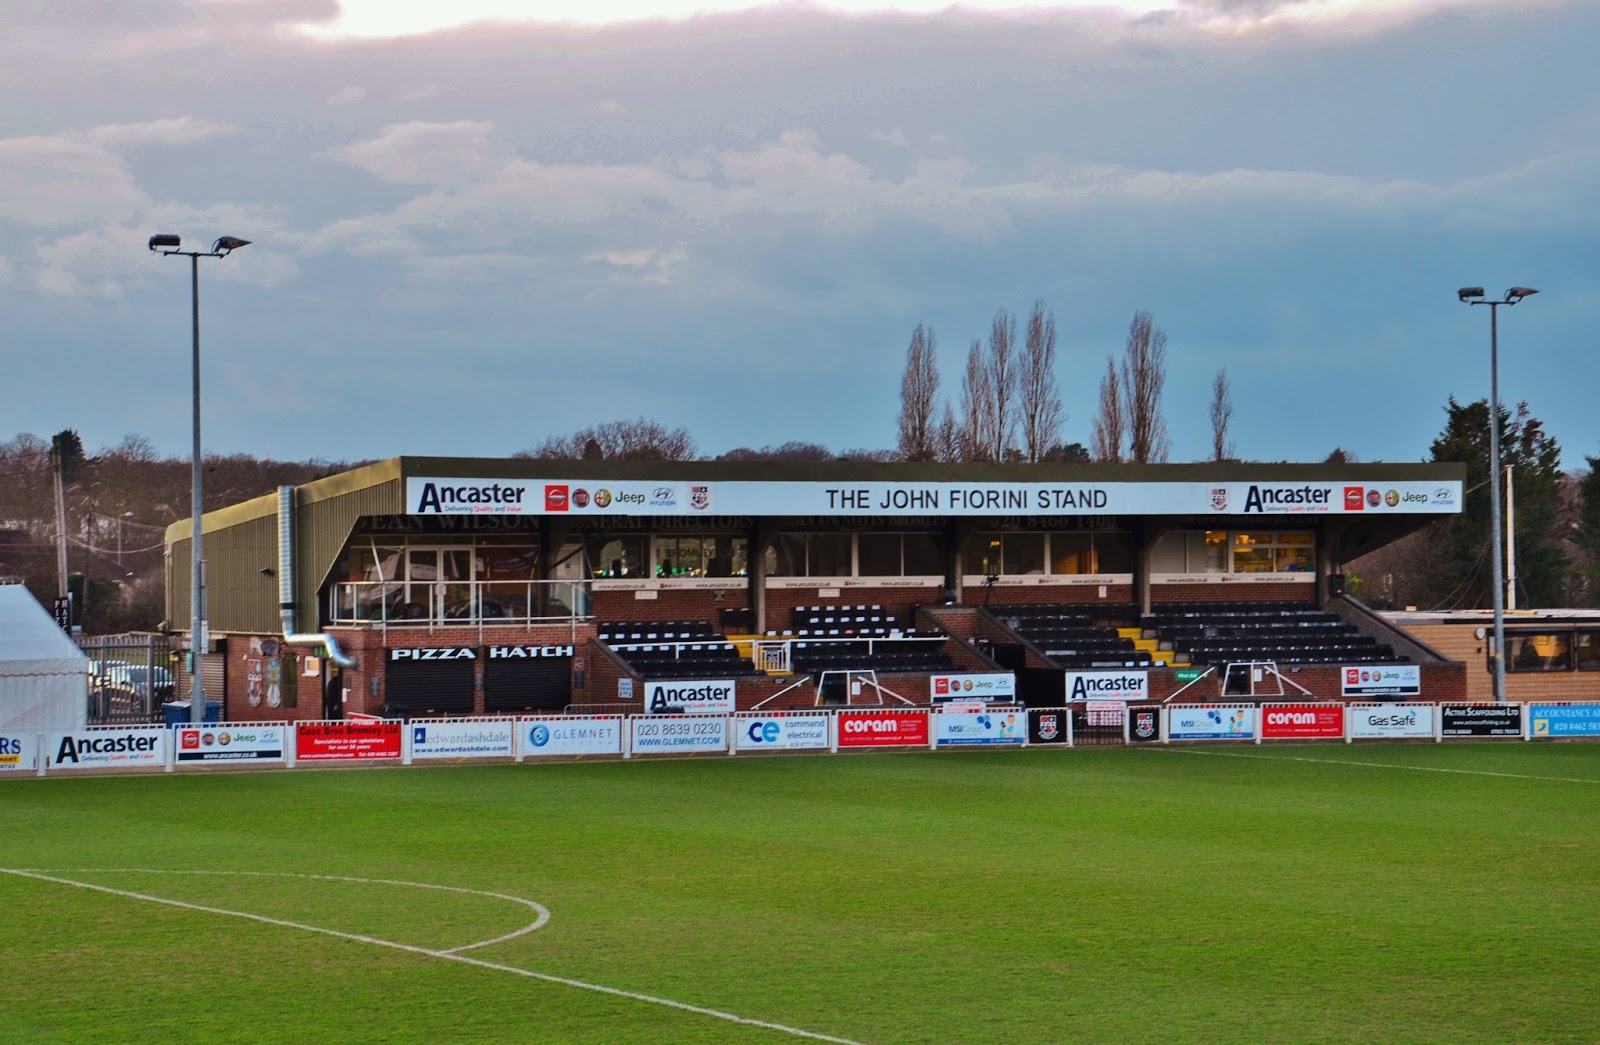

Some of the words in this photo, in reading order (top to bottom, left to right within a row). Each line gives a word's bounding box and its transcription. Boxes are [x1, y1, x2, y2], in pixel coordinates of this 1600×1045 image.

[418, 483, 525, 513] Ancaster
[615, 491, 646, 504] Jeep
[825, 490, 870, 509] THE
[880, 490, 939, 509] JOHN
[949, 490, 1028, 509] FIORINI
[1037, 490, 1108, 509] STAND
[1244, 485, 1331, 512] Ancaster
[1402, 492, 1428, 504] Jeep
[445, 505, 473, 513] Delivering
[474, 505, 494, 513] Quality
[391, 647, 476, 660] PIZZA
[489, 645, 574, 658] HATCH
[1071, 675, 1144, 699] Ancaster
[650, 684, 731, 710] Ancaster
[1267, 712, 1316, 725] coram
[1535, 709, 1590, 718] ACCOUNTANCY
[785, 719, 825, 728] command
[845, 719, 897, 733] coram
[1368, 715, 1389, 726] Gas
[1390, 715, 1416, 726] Safe
[1554, 722, 1569, 731] 020
[1569, 722, 1586, 730] 8462
[300, 727, 321, 735] Cass
[324, 727, 344, 735] Bros
[346, 726, 382, 735] Bromley
[384, 725, 398, 734] Ltd
[553, 729, 612, 739] GLEMNET
[638, 724, 659, 736] 020
[662, 723, 690, 735] 8639
[693, 723, 721, 734] 0230
[787, 730, 823, 739] electrical
[233, 732, 257, 743] Jeep
[426, 732, 509, 743] edwardashdale
[638, 737, 720, 746] WWW.GLEMNET.COM
[56, 734, 158, 764] Ancaster
